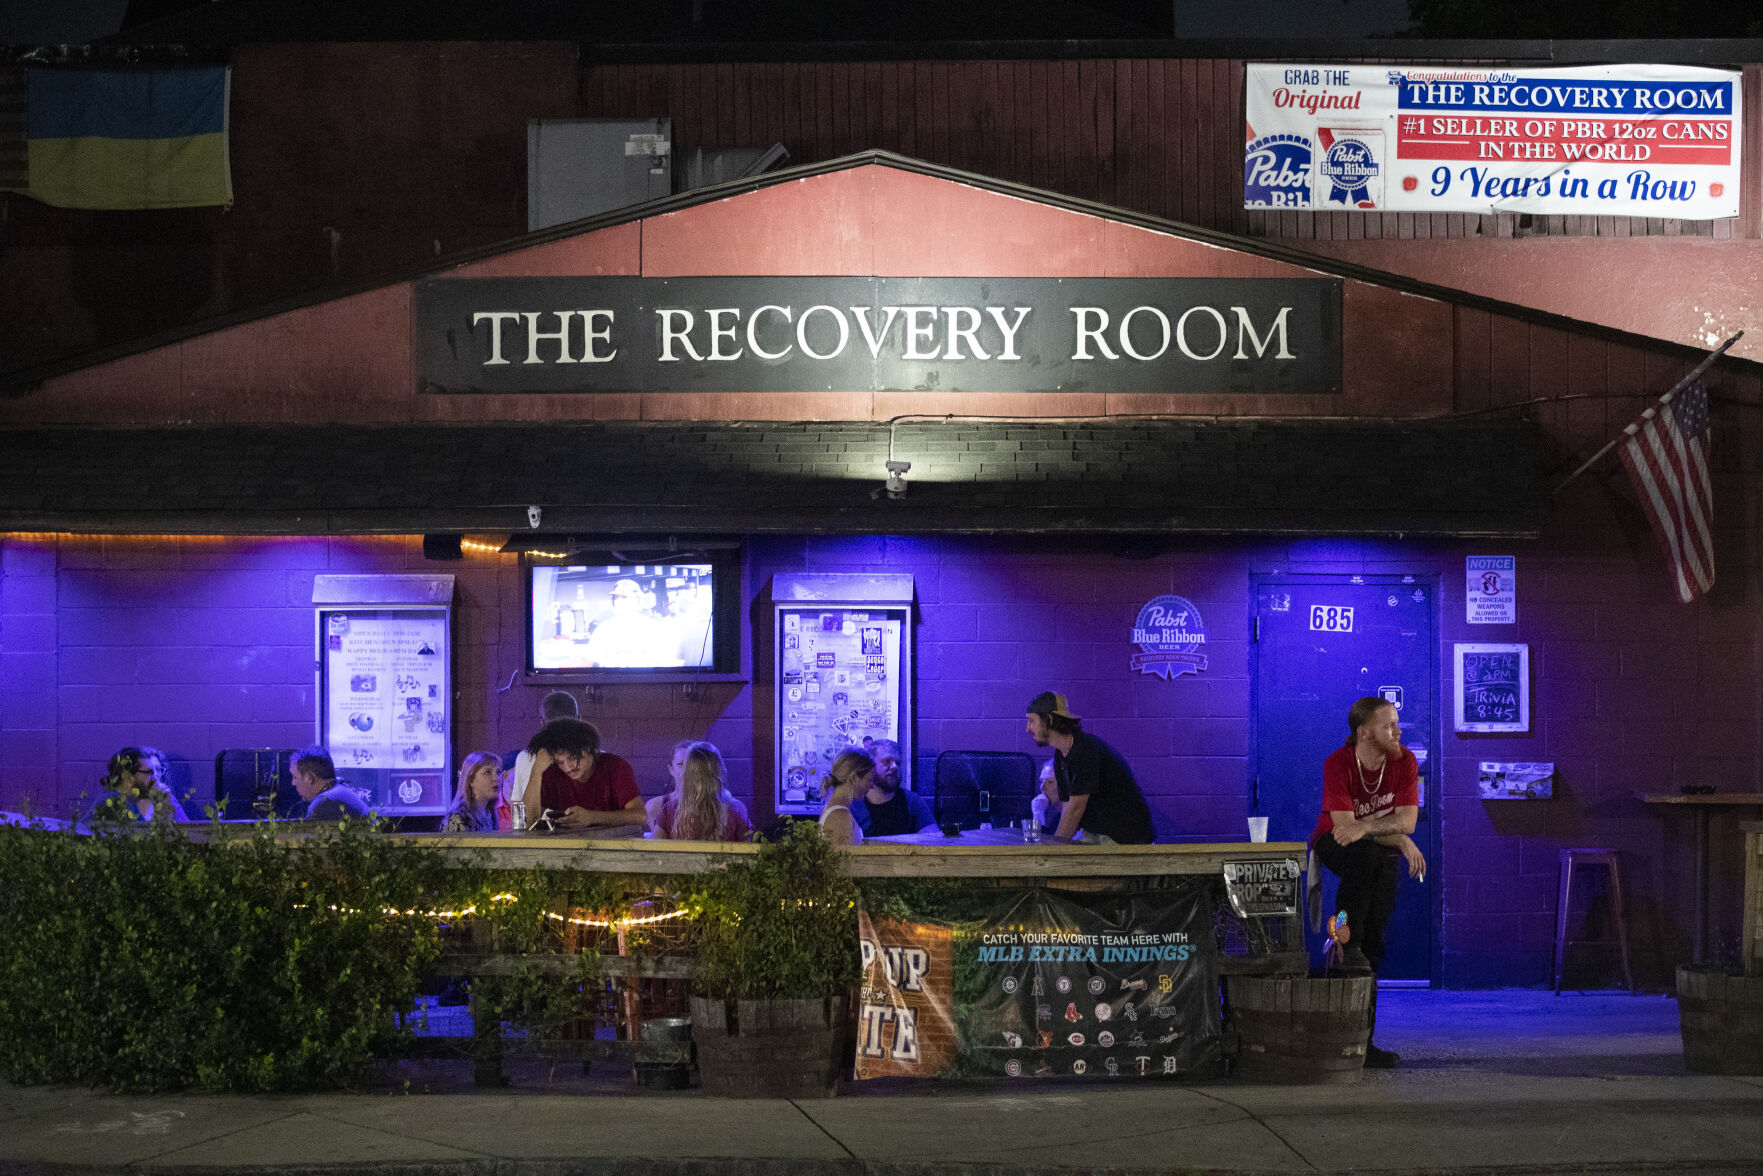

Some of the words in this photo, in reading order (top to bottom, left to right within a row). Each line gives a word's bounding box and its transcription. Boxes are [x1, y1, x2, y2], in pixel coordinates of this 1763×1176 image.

[1285, 69, 1319, 85] GRAB
[1324, 70, 1350, 86] THE
[1405, 70, 1487, 85] Congratulations
[1489, 72, 1500, 82] to
[1501, 73, 1517, 82] the
[1272, 87, 1361, 115] Original
[1407, 83, 1466, 105] THE
[1472, 85, 1629, 108] RECOVERY
[1633, 88, 1725, 109] ROOM
[1403, 117, 1426, 135] #1
[1432, 118, 1520, 137] SELLER
[1524, 120, 1557, 138] OF
[1561, 121, 1607, 139] PBR
[1612, 122, 1657, 139] 12oz
[1662, 122, 1728, 140] CANS
[1333, 145, 1366, 162] Pabst
[1479, 141, 1505, 159] IN
[1509, 141, 1557, 159] THE
[1560, 142, 1651, 161] WORLD
[1246, 150, 1312, 187] Pabst
[1321, 162, 1343, 175] Blue
[1344, 163, 1378, 176] Ribbon
[1430, 166, 1451, 197] 9
[1459, 167, 1551, 198] Years
[1559, 169, 1589, 198] in
[1597, 178, 1618, 199] a
[1626, 169, 1696, 201] Row
[473, 309, 618, 366] THE
[655, 304, 1032, 361] RECOVERY
[1069, 305, 1297, 361] ROOM
[1470, 559, 1511, 569] NOTICE
[1148, 606, 1189, 627] Pabst
[1312, 606, 1351, 631] 685
[1132, 628, 1160, 643] Blue
[1162, 628, 1206, 643] Ribbon
[1465, 654, 1512, 669] OPEN
[1482, 669, 1511, 681] 2PM
[1477, 704, 1516, 721] 8:45
[1353, 799, 1370, 817] Rec
[1370, 792, 1397, 813] Room
[1235, 863, 1288, 883] PRIVATE
[983, 933, 1017, 944] CATCH
[1020, 933, 1048, 944] YOUR
[1050, 933, 1098, 945] FAVORITE
[1100, 935, 1129, 946] TEAM
[1131, 934, 1160, 945] HERE
[1162, 932, 1188, 943] WITH
[977, 945, 1024, 962] MLB
[1028, 945, 1097, 962] EXTRA
